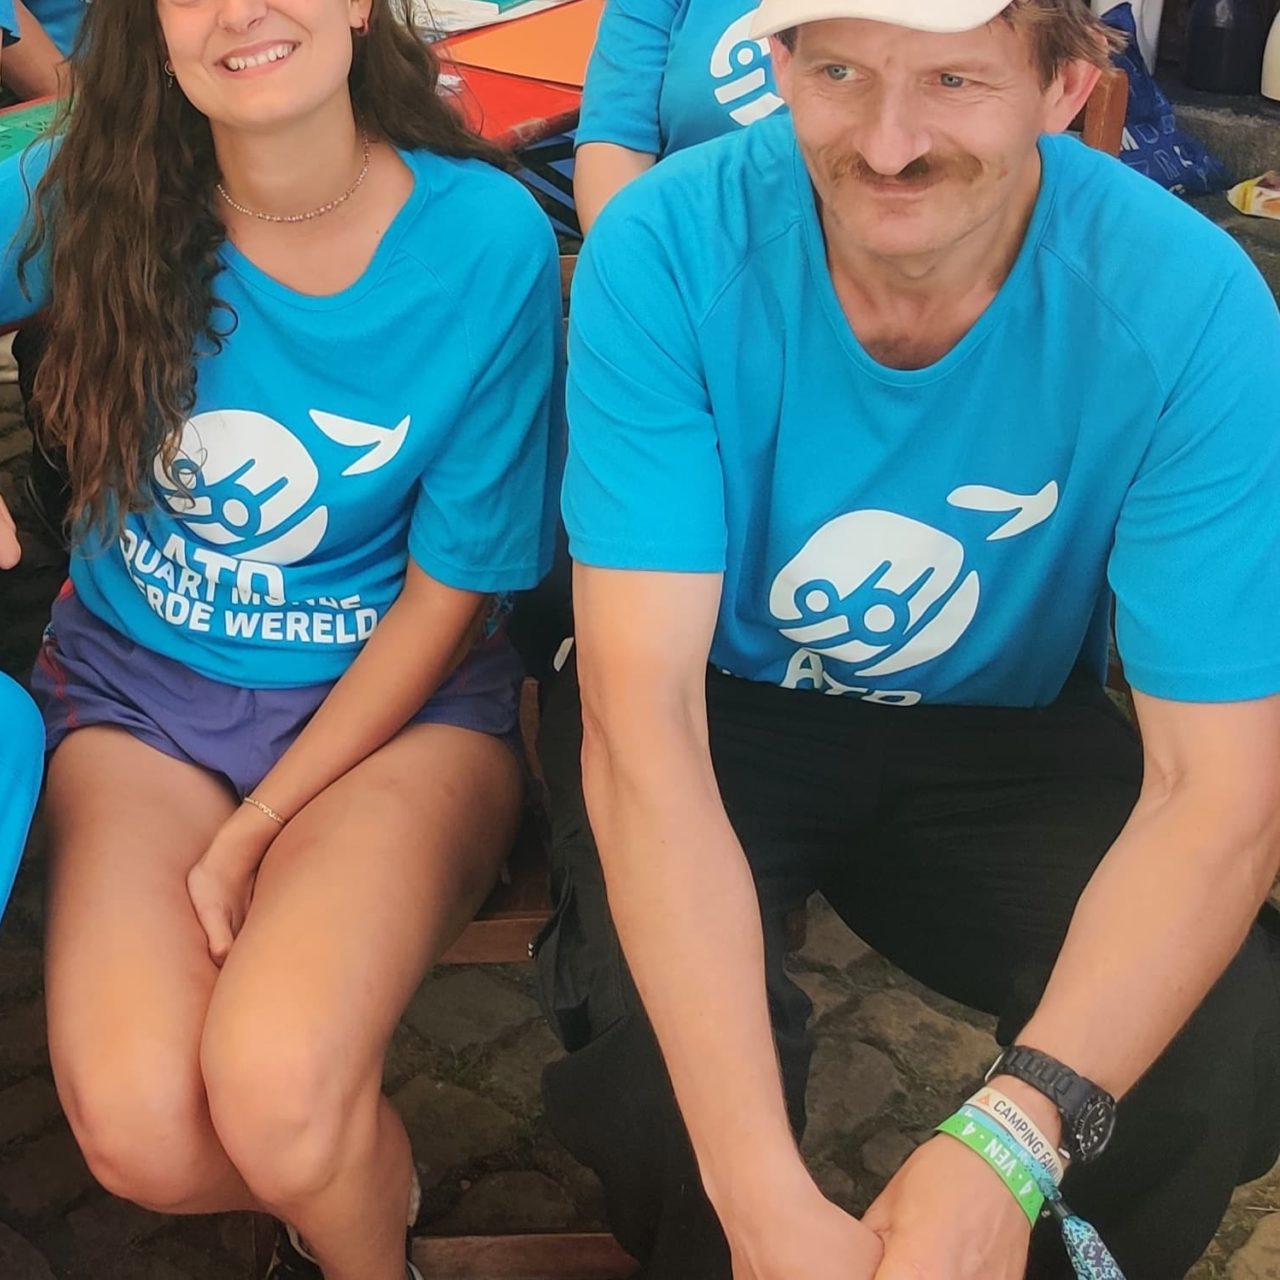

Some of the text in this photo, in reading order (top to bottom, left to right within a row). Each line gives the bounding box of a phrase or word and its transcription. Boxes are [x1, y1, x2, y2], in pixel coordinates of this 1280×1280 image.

[224, 607, 378, 644] WERELD
[961, 1121, 976, 1137] 4
[993, 1099, 1047, 1155] CAMPING
[983, 1137, 1018, 1177] VEN
